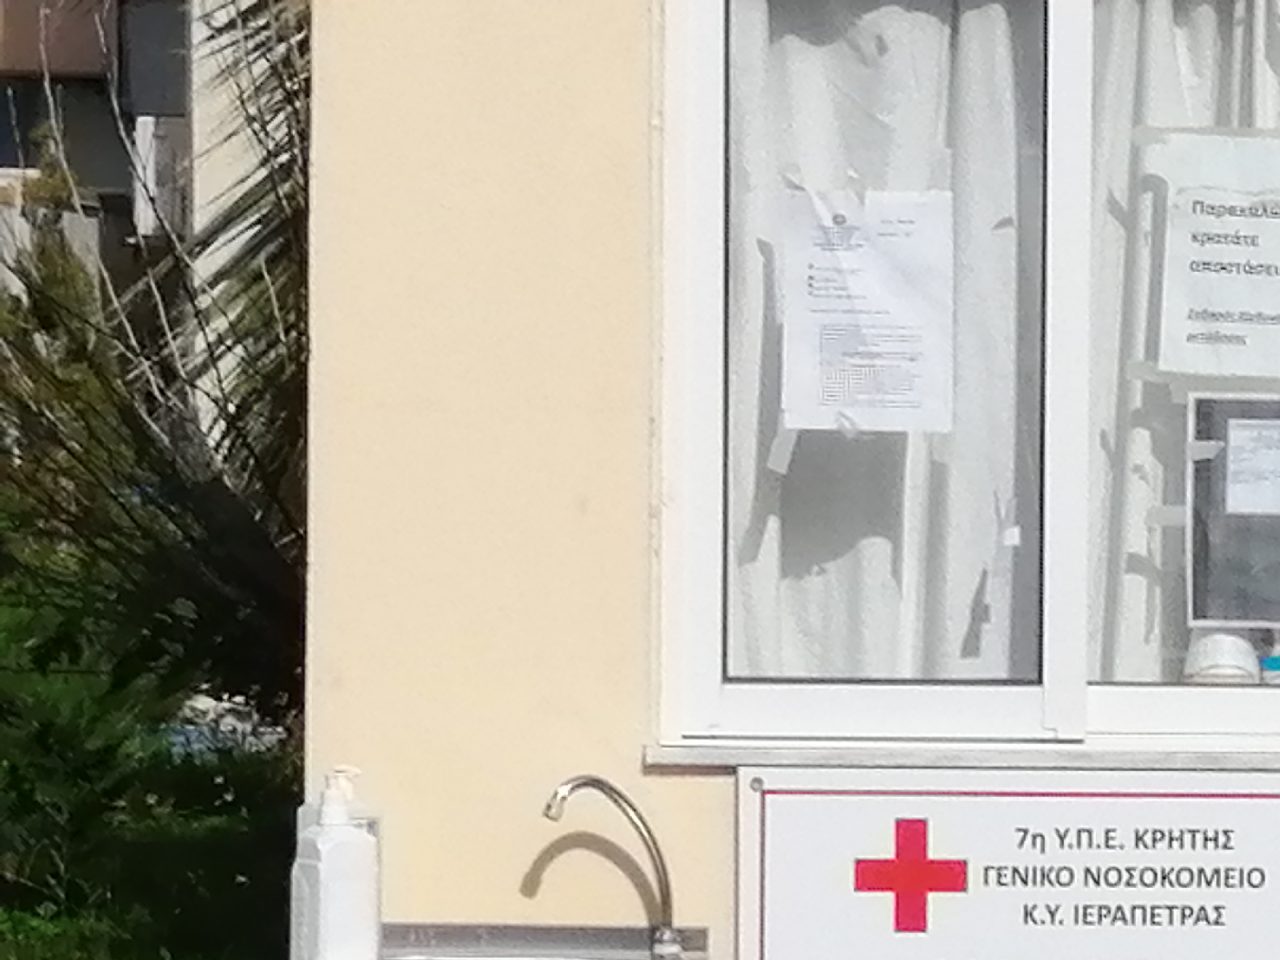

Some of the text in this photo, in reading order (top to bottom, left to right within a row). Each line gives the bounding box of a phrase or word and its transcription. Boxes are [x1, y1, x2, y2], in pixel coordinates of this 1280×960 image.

[1015, 828, 1236, 854] 7η Υ.Π.Ε. ΚΡΗΤΗΣ
[983, 866, 1267, 890] ΓΕΝΙΚΟ ΝΟΣΟΚΟΜΕΙΟ
[1022, 904, 1227, 928] Κ.Υ. ΙΕΡΑΠΕΤΡΑΣ
